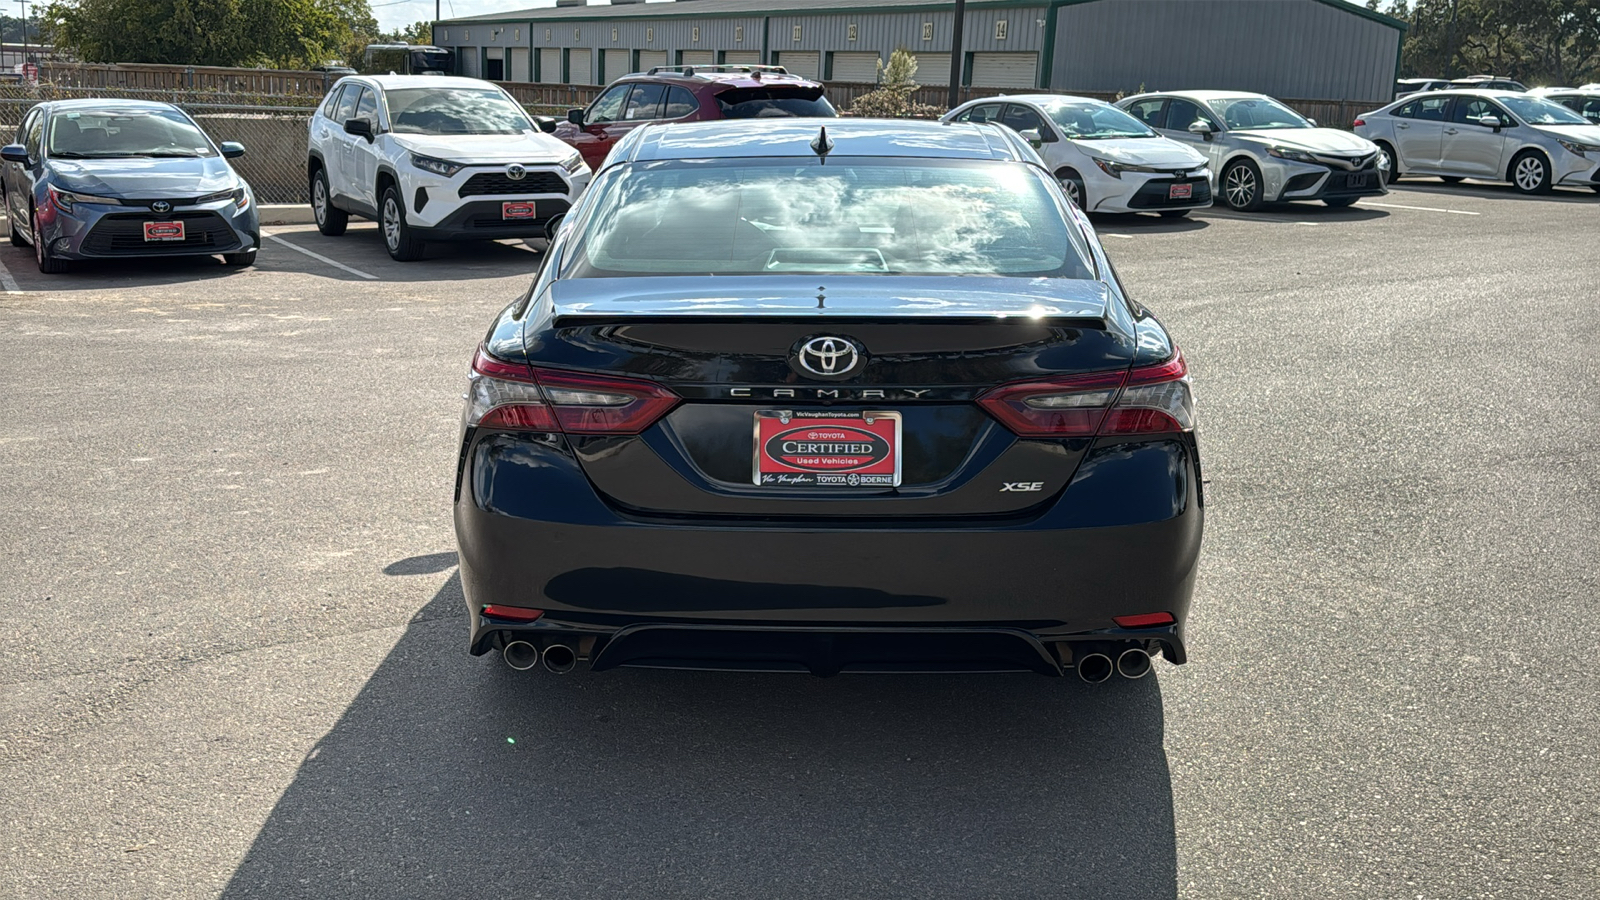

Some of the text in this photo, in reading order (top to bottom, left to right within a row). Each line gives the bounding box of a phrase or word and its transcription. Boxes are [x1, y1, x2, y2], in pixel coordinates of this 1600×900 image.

[794, 27, 801, 39] 11
[848, 26, 856, 38] 12
[923, 24, 932, 38] 13
[996, 22, 1006, 37] 14
[730, 388, 931, 398] CAMRY
[782, 441, 873, 454] CERTIFIED
[796, 457, 859, 465] Used Vehicles
[999, 481, 1045, 492] XSE
